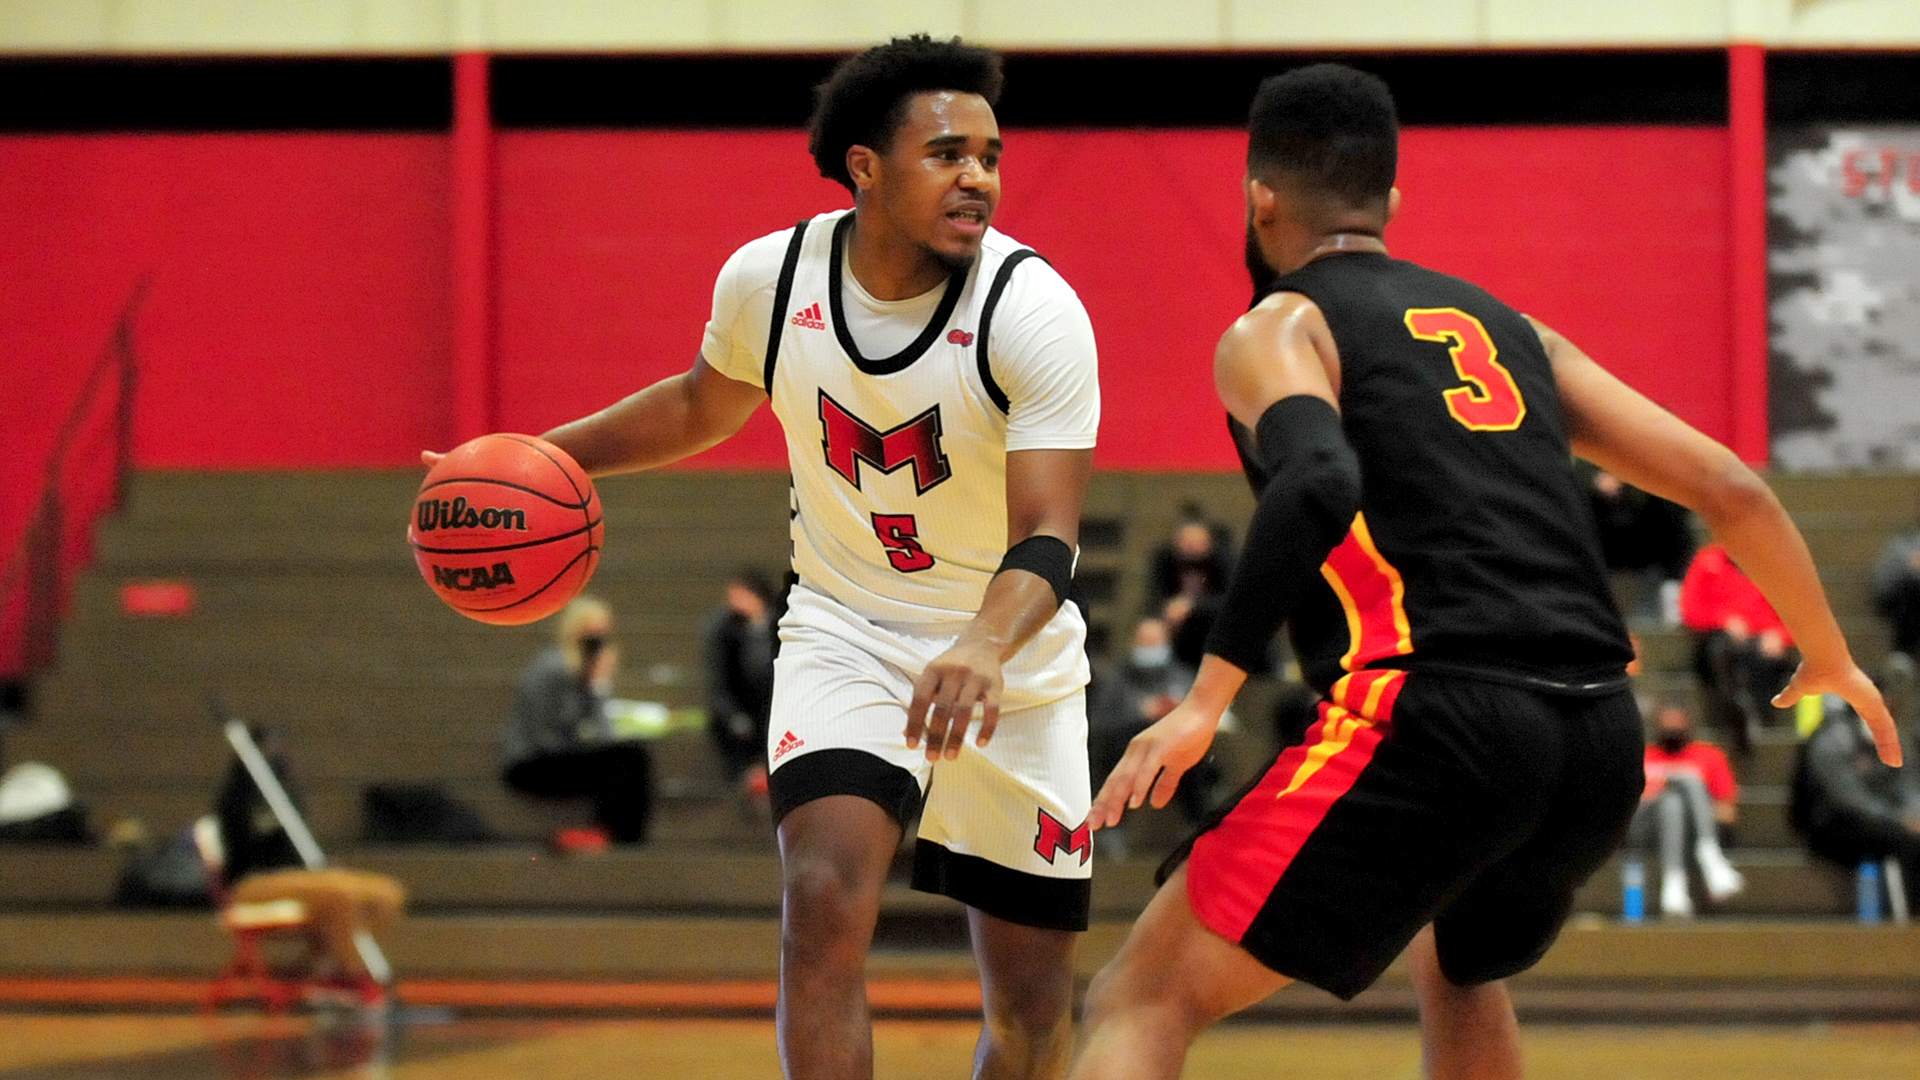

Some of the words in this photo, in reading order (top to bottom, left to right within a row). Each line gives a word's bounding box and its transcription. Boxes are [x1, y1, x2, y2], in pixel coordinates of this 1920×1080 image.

[791, 316, 826, 331] adidas
[1403, 307, 1527, 432] 3
[818, 386, 952, 497] M
[418, 496, 527, 532] Wilson
[870, 512, 935, 573] 5
[433, 562, 515, 592] NCAA
[773, 740, 805, 762] adidas
[1033, 806, 1091, 867] M
